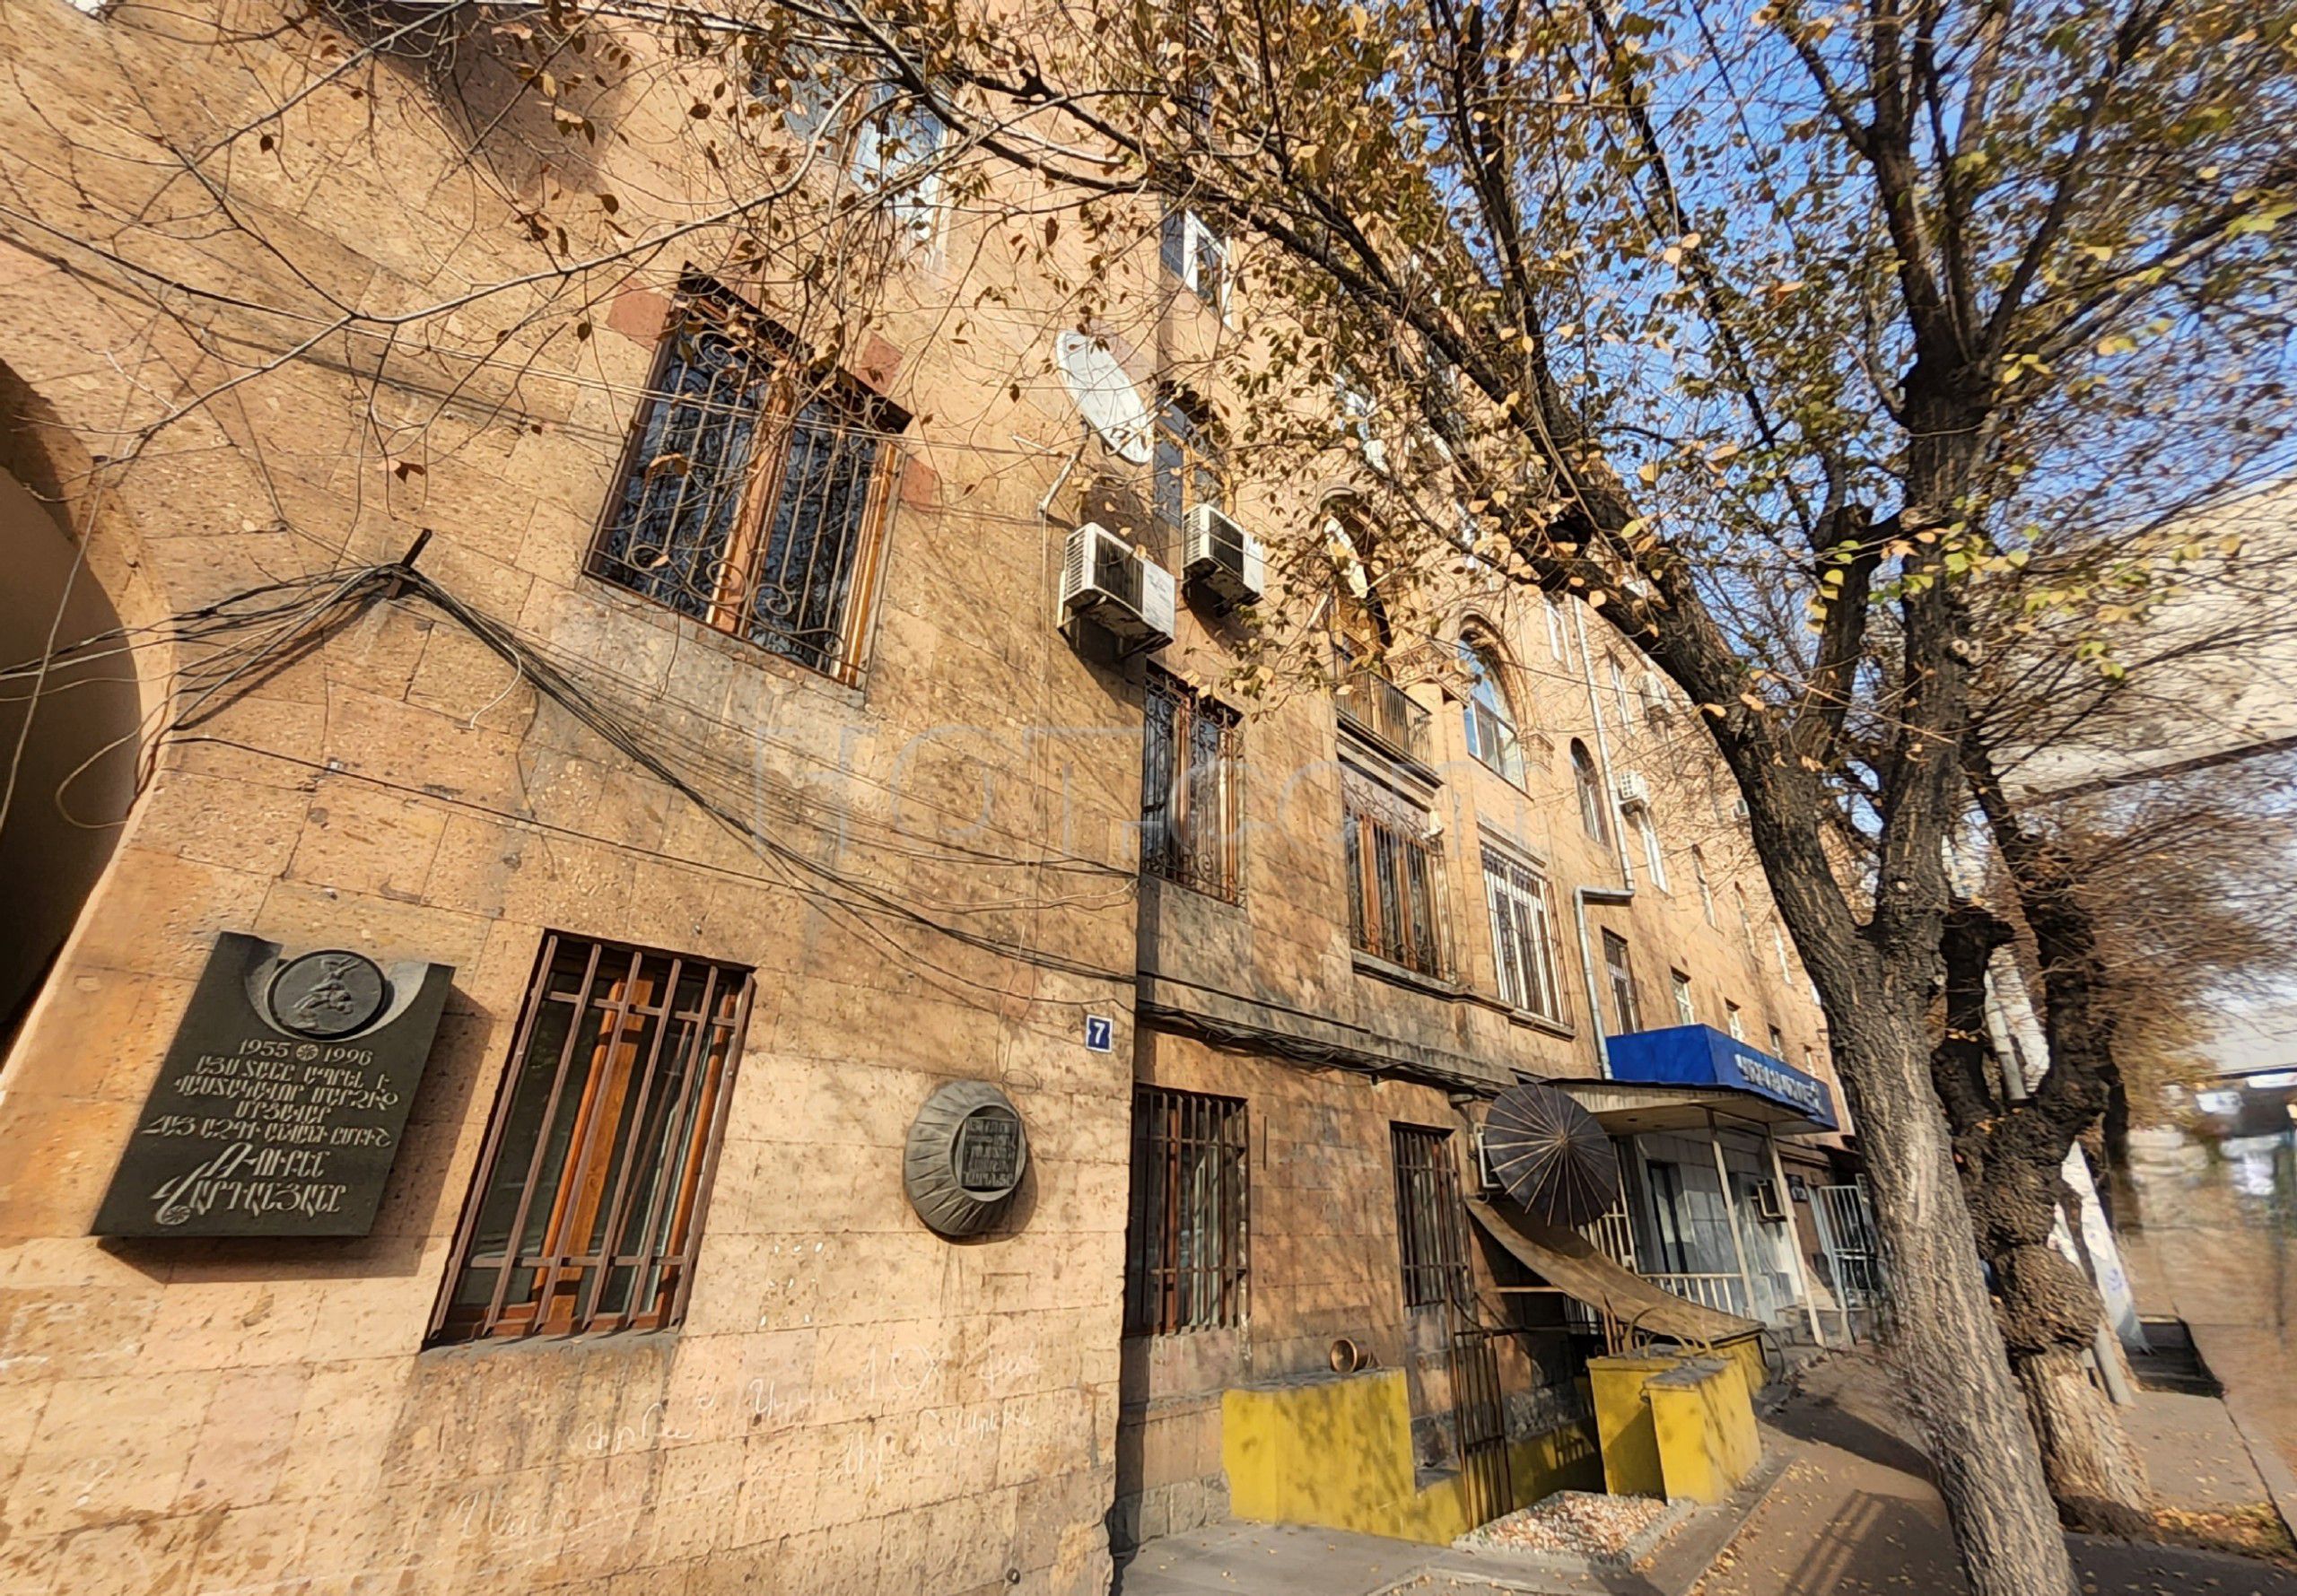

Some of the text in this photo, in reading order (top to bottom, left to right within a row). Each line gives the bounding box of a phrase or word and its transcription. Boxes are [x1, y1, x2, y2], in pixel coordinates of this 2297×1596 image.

[1092, 1022, 1105, 1045] 7
[238, 1038, 374, 1067] 1955 1996
[195, 1054, 241, 1076] ԱՅՍ
[241, 1060, 296, 1081] ՏԱՆԸ
[376, 1073, 392, 1090] Է
[172, 1074, 305, 1103] ՎԱՍՏԱԿԱՎՈՐ
[141, 1114, 197, 1137] ՀԱՅ
[199, 1119, 262, 1141] ԱԶԳԻ
